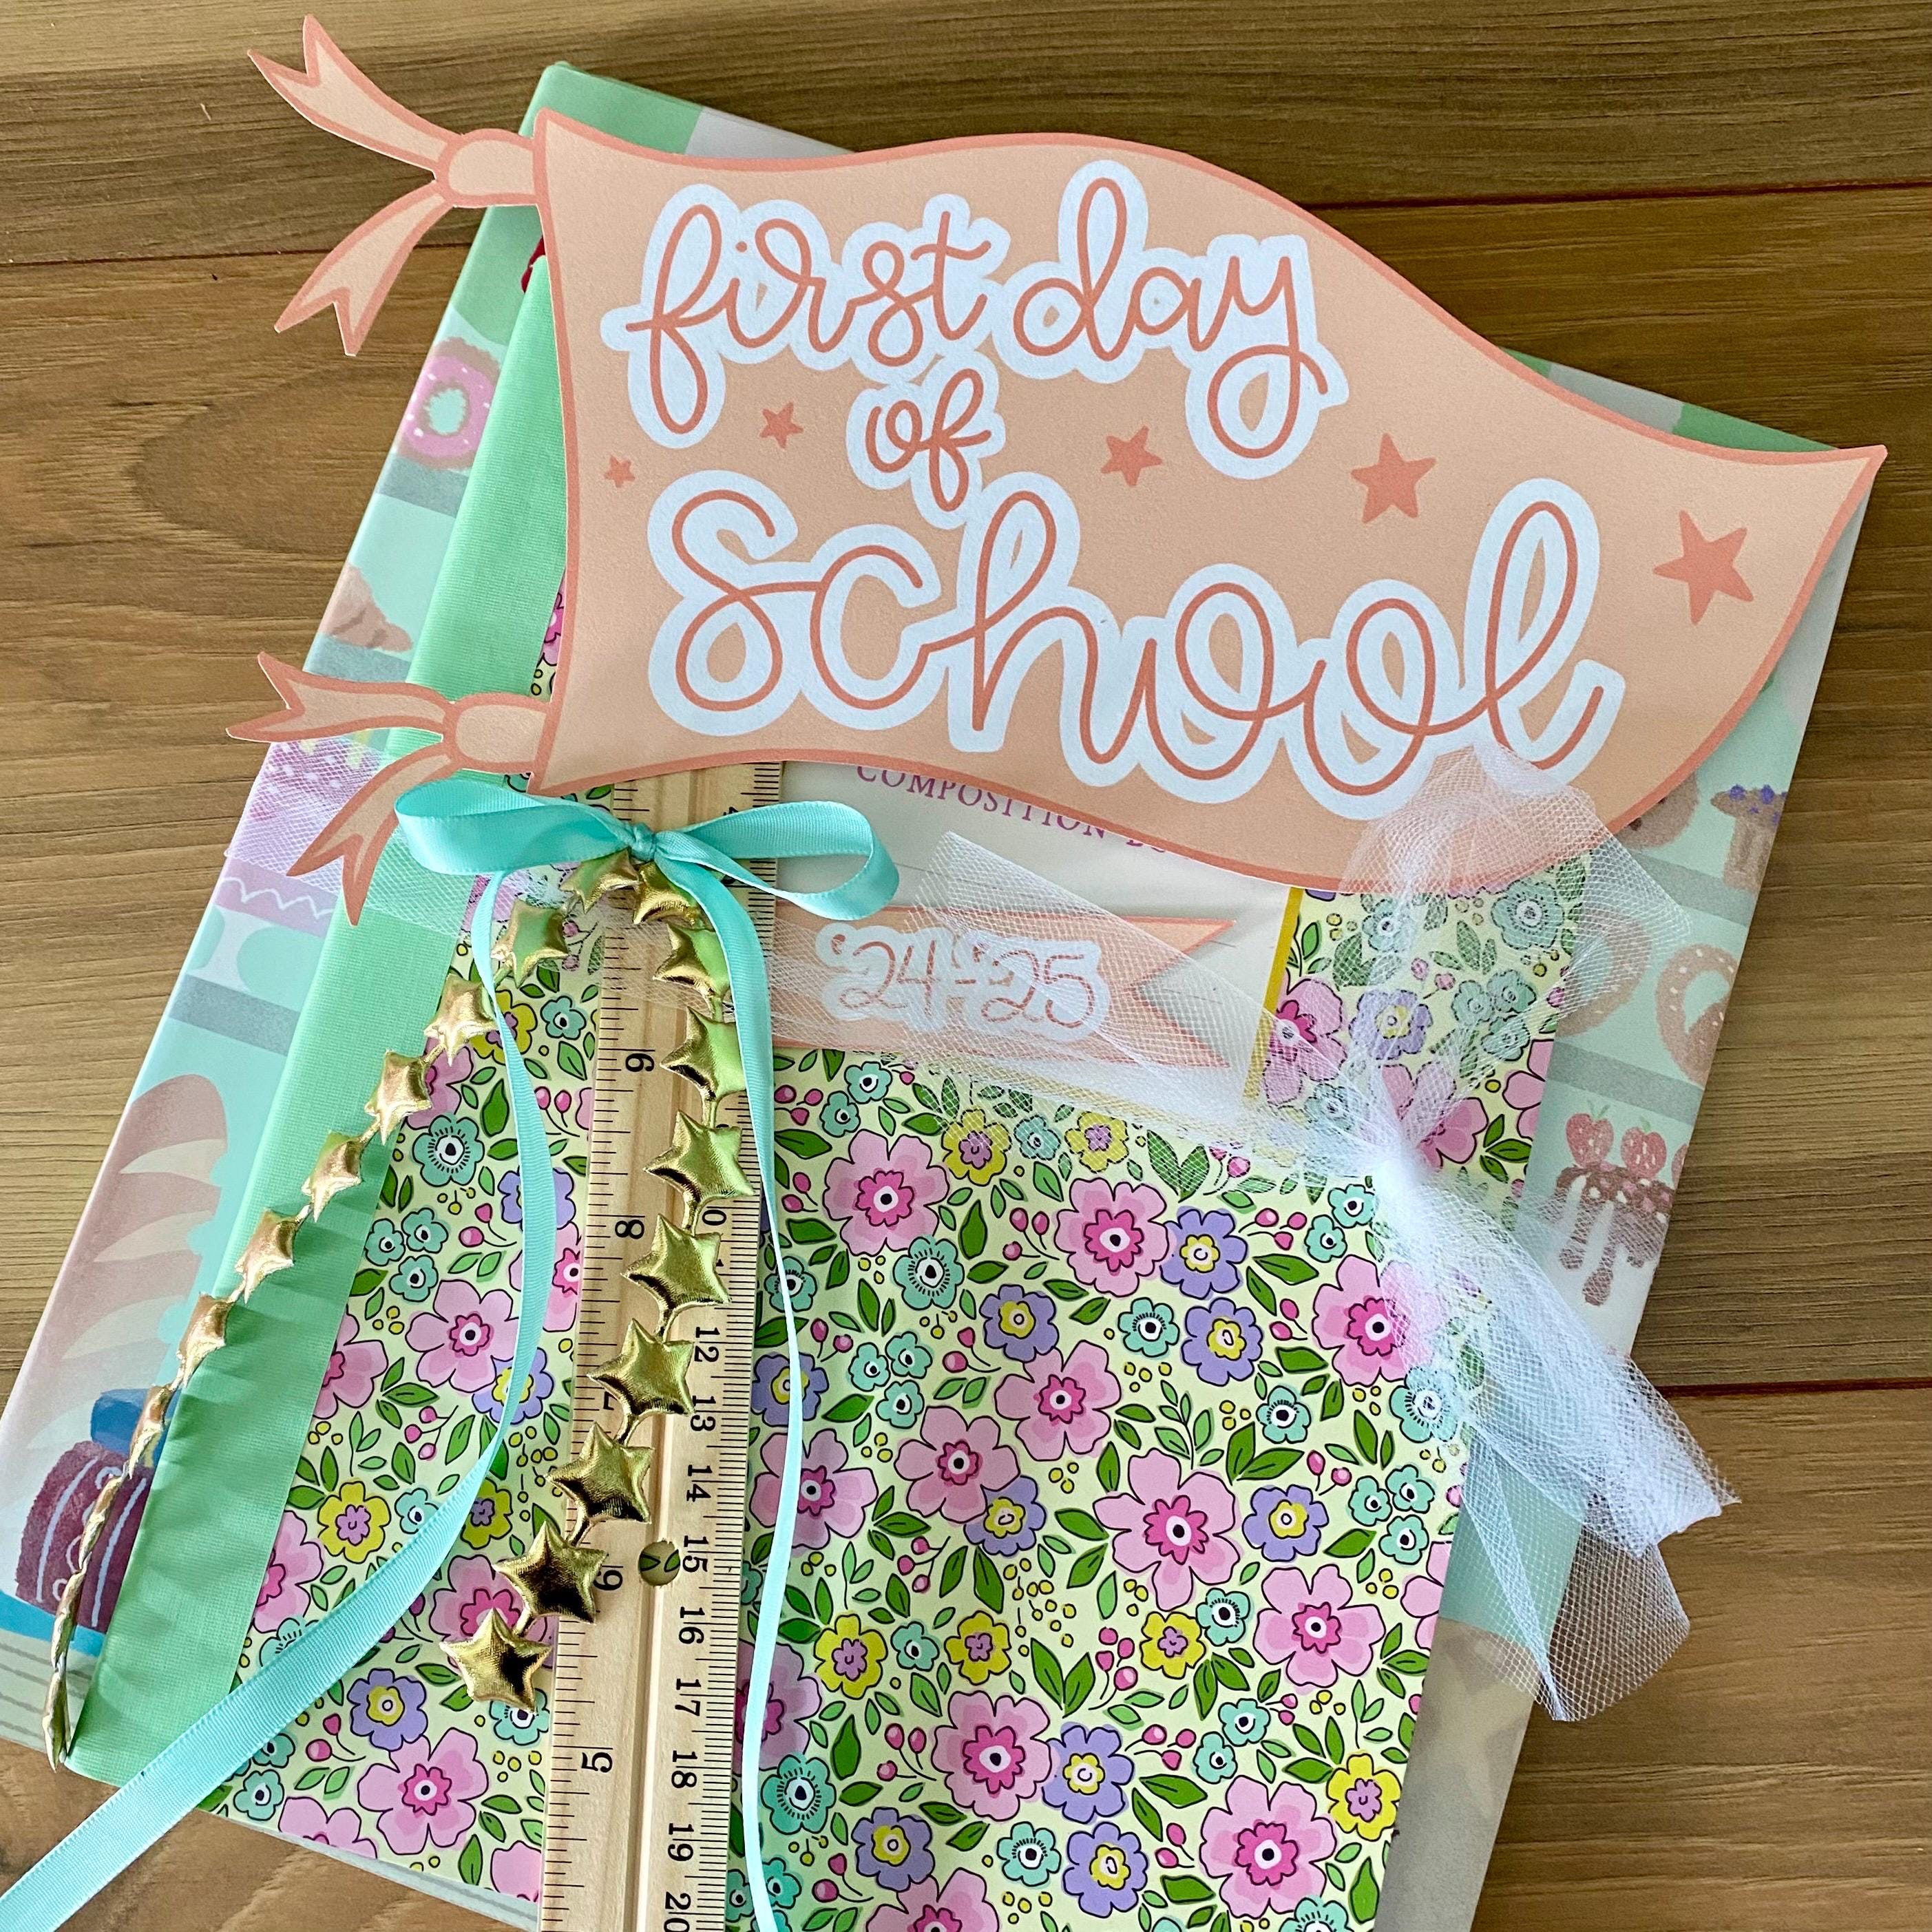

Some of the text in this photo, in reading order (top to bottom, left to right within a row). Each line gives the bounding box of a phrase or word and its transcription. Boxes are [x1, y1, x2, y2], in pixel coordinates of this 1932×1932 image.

[627, 178, 1328, 459] first day
[865, 368, 991, 511] of
[626, 1053, 655, 1071] 9
[615, 1219, 644, 1240] 8
[695, 1326, 719, 1363] 12
[691, 1395, 715, 1431] 13
[686, 1464, 711, 1502] 14
[682, 1535, 708, 1573] 15
[593, 1570, 623, 1591] 6
[678, 1606, 705, 1645] 16
[674, 1677, 702, 1716] 17
[581, 1752, 613, 1773] 5
[671, 1750, 697, 1789] 18
[667, 1823, 694, 1862] 19
[664, 1891, 691, 1932] 20
